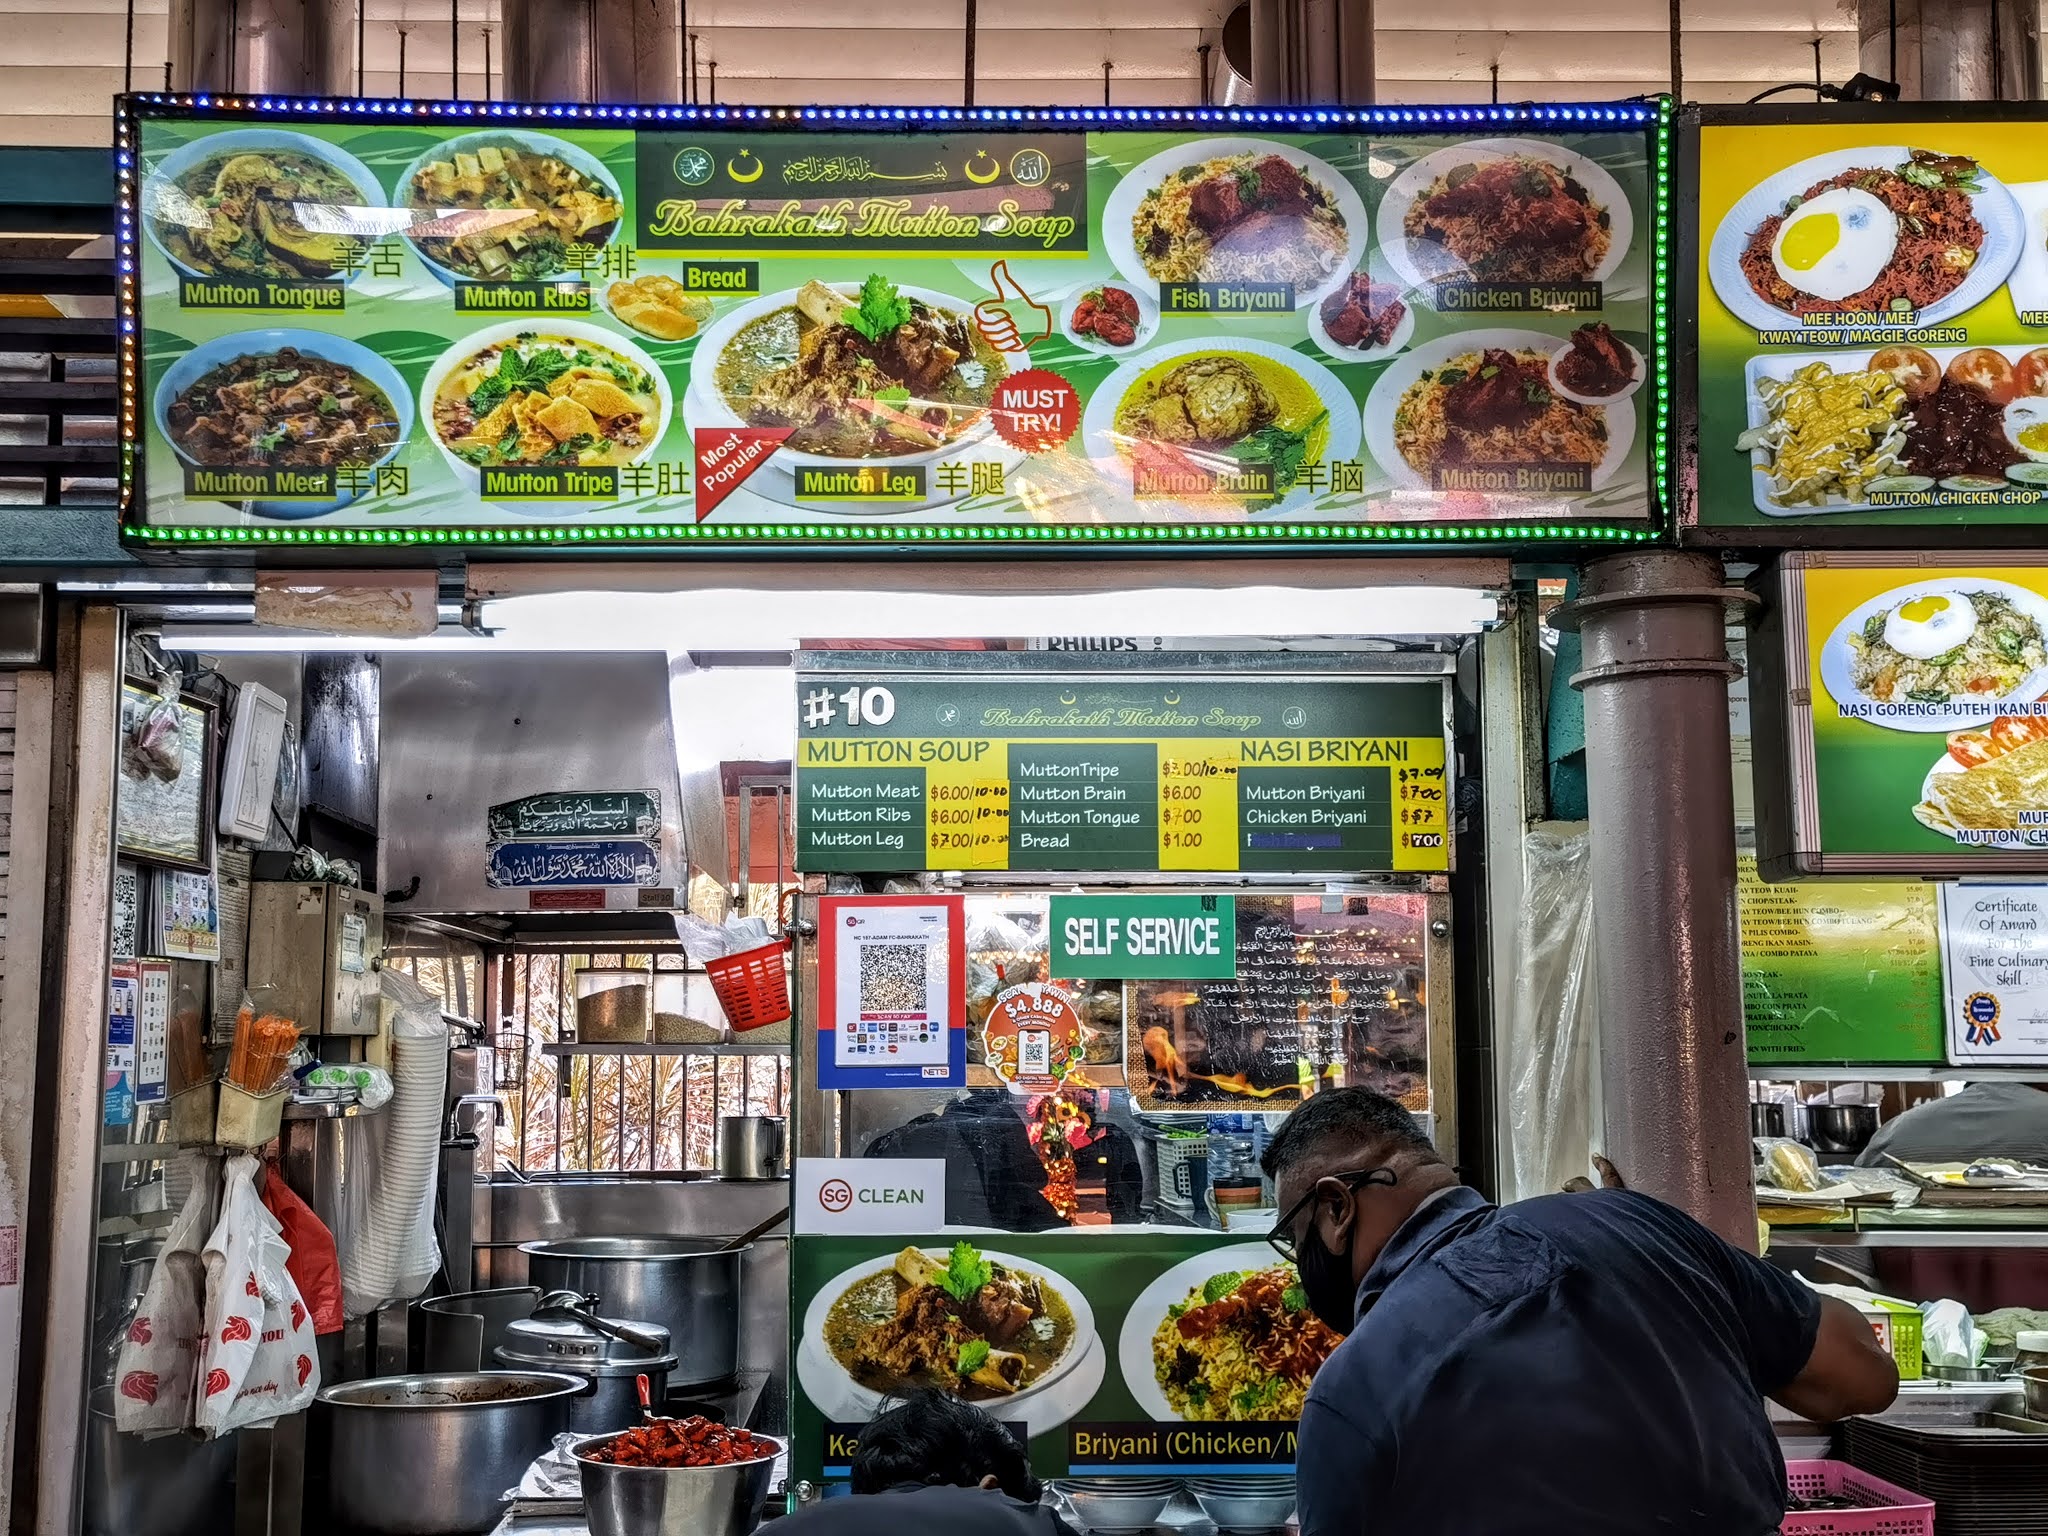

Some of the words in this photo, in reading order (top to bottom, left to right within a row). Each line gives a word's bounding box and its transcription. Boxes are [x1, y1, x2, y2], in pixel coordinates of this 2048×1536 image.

[650, 199, 846, 238] Bahrakath
[851, 199, 980, 238] Mutton
[981, 199, 1076, 248] Soup
[330, 241, 405, 278] 羊舌
[566, 243, 637, 279] 羊排
[688, 266, 747, 290] Bread
[186, 282, 262, 305] Mutton
[266, 284, 342, 310] Tongue
[464, 286, 539, 308] Mutton
[544, 285, 589, 308] Ribs
[1171, 288, 1214, 309] Fish
[1218, 288, 1286, 312] Briyani
[1444, 287, 1523, 309] Chicken
[1530, 288, 1598, 313] Briyani
[1803, 312, 1832, 326] MEE
[1835, 311, 1883, 326] HOON/
[1885, 311, 1919, 326] MEE/
[1759, 330, 1798, 345] KWAY
[1799, 330, 1848, 344] TEOW/
[1850, 329, 1904, 344] MAGGIE
[1906, 329, 1966, 344] GORENG
[1003, 389, 1068, 409] MUST
[1008, 411, 1062, 432] TRY!
[701, 432, 743, 468] Most
[703, 439, 763, 491] Popular
[194, 471, 270, 494] Mutton
[275, 471, 329, 494] Meat
[336, 463, 409, 497] 羊肉
[487, 472, 560, 494] Mutton
[563, 472, 613, 497] Tripe
[620, 463, 692, 497] 羊肚
[804, 472, 875, 494] Mutton
[882, 472, 917, 498] Leg
[935, 461, 1005, 497] 羊腿
[1140, 470, 1209, 491] Mutton
[1216, 469, 1268, 490] Brain
[1296, 461, 1364, 495] 羊脑
[1441, 468, 1514, 490] Mutton
[1518, 467, 1585, 493] Briyani
[1870, 490, 1937, 505] MUTTON/
[1938, 490, 1998, 505] CHICKEN
[2001, 490, 2041, 505] CHOP
[1047, 636, 1139, 651] PHILIPS
[802, 686, 896, 728] #10
[1839, 703, 1873, 717] NASI
[1875, 703, 1937, 717] GORENG
[1944, 703, 1990, 717] PUTEH
[1994, 703, 2029, 716] IKAN
[980, 707, 1115, 728] Bahrakath
[1113, 707, 1199, 728] Mutton
[1202, 707, 1262, 732] Soup
[807, 740, 912, 762] MUTTON
[919, 740, 991, 762] SOUP
[1241, 740, 1301, 762] NASI
[1307, 740, 1409, 762] BRIYANI
[811, 784, 872, 799] Mutton
[876, 784, 920, 799] Meat
[1020, 786, 1078, 801] Mutton
[1083, 786, 1126, 801] Brain
[1163, 784, 1202, 802] $6.00
[1246, 786, 1305, 800] Mutton
[1310, 785, 1365, 803] Briyani
[811, 808, 872, 822] Mutton
[876, 807, 911, 822] Ribs
[1020, 810, 1078, 825] Mutton
[1084, 810, 1140, 828] Tongue
[1246, 809, 1307, 823] Chicken
[1311, 808, 1367, 827] Briyani
[811, 832, 872, 846] Mutton
[876, 832, 904, 849] Leg
[1020, 833, 1070, 848] Bread
[1163, 832, 1203, 849] $1.00
[1956, 829, 2026, 843] MUTTON/
[1975, 897, 2038, 915] Certificate
[1979, 915, 1995, 934] Of
[1999, 918, 2037, 931] Award
[1064, 917, 1119, 956] SELF
[1126, 916, 1220, 955] SERVICE
[1988, 937, 2007, 949] For
[2010, 933, 2033, 951] The
[1969, 955, 1995, 967] Fine
[1997, 952, 2048, 970] Culinary
[1996, 970, 2022, 987] Skill
[825, 1188, 849, 1203] SG
[858, 1188, 924, 1205] CLEAN
[262, 1329, 284, 1343] YOU
[1075, 1431, 1158, 1460] Briyani
